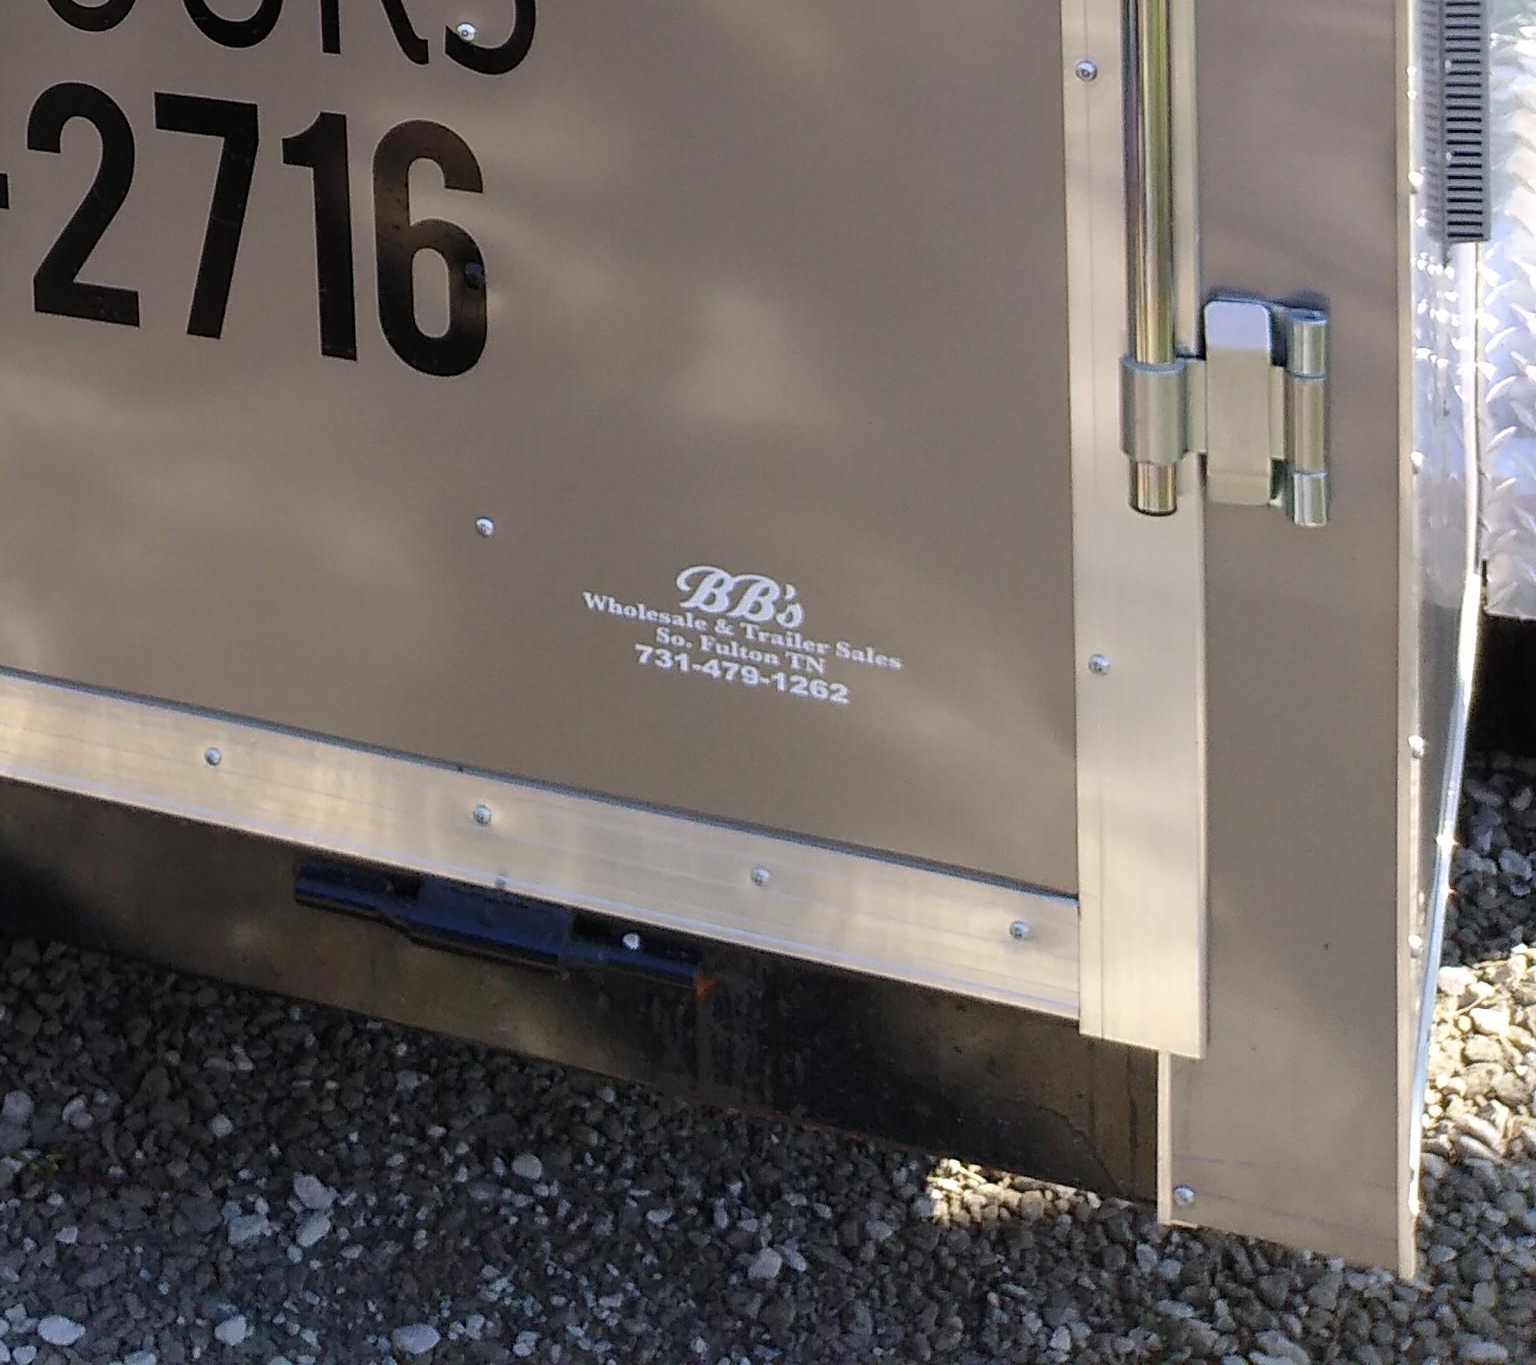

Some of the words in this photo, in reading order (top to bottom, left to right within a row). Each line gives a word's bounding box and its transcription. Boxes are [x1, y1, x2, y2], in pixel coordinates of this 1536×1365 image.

[676, 565, 805, 628] BB's
[582, 591, 708, 632] Wholesale
[714, 619, 735, 636] &
[739, 622, 831, 655] Trailer
[835, 642, 903, 670] Sales
[655, 627, 693, 649] So.
[700, 635, 781, 666] Fulton
[784, 652, 827, 675] TN
[634, 644, 851, 704] 731-479-1262
